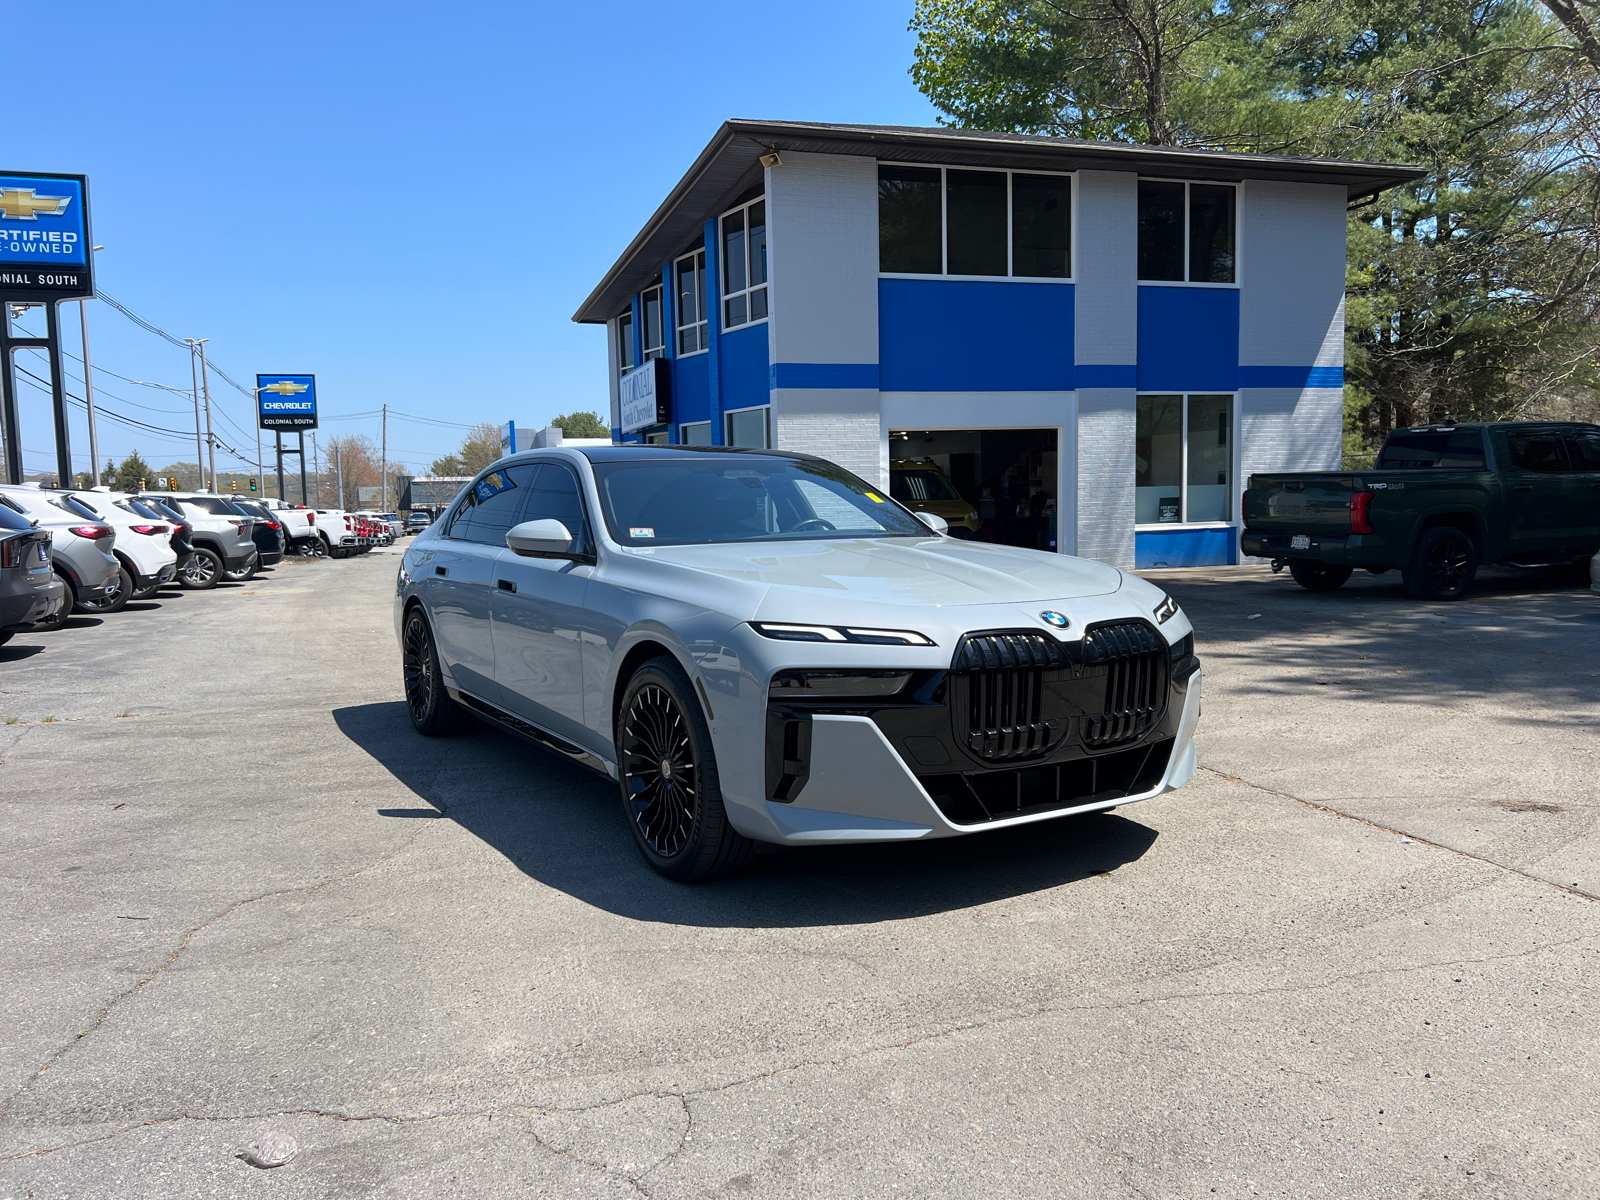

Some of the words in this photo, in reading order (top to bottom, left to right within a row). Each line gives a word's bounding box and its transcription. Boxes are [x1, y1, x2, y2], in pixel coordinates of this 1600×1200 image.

[0, 273, 31, 284] NIAL
[38, 274, 78, 285] SOUTH
[264, 402, 312, 410] CHEVROLET
[1367, 482, 1387, 490] TRD
[1264, 504, 1324, 516] TUNDRA
